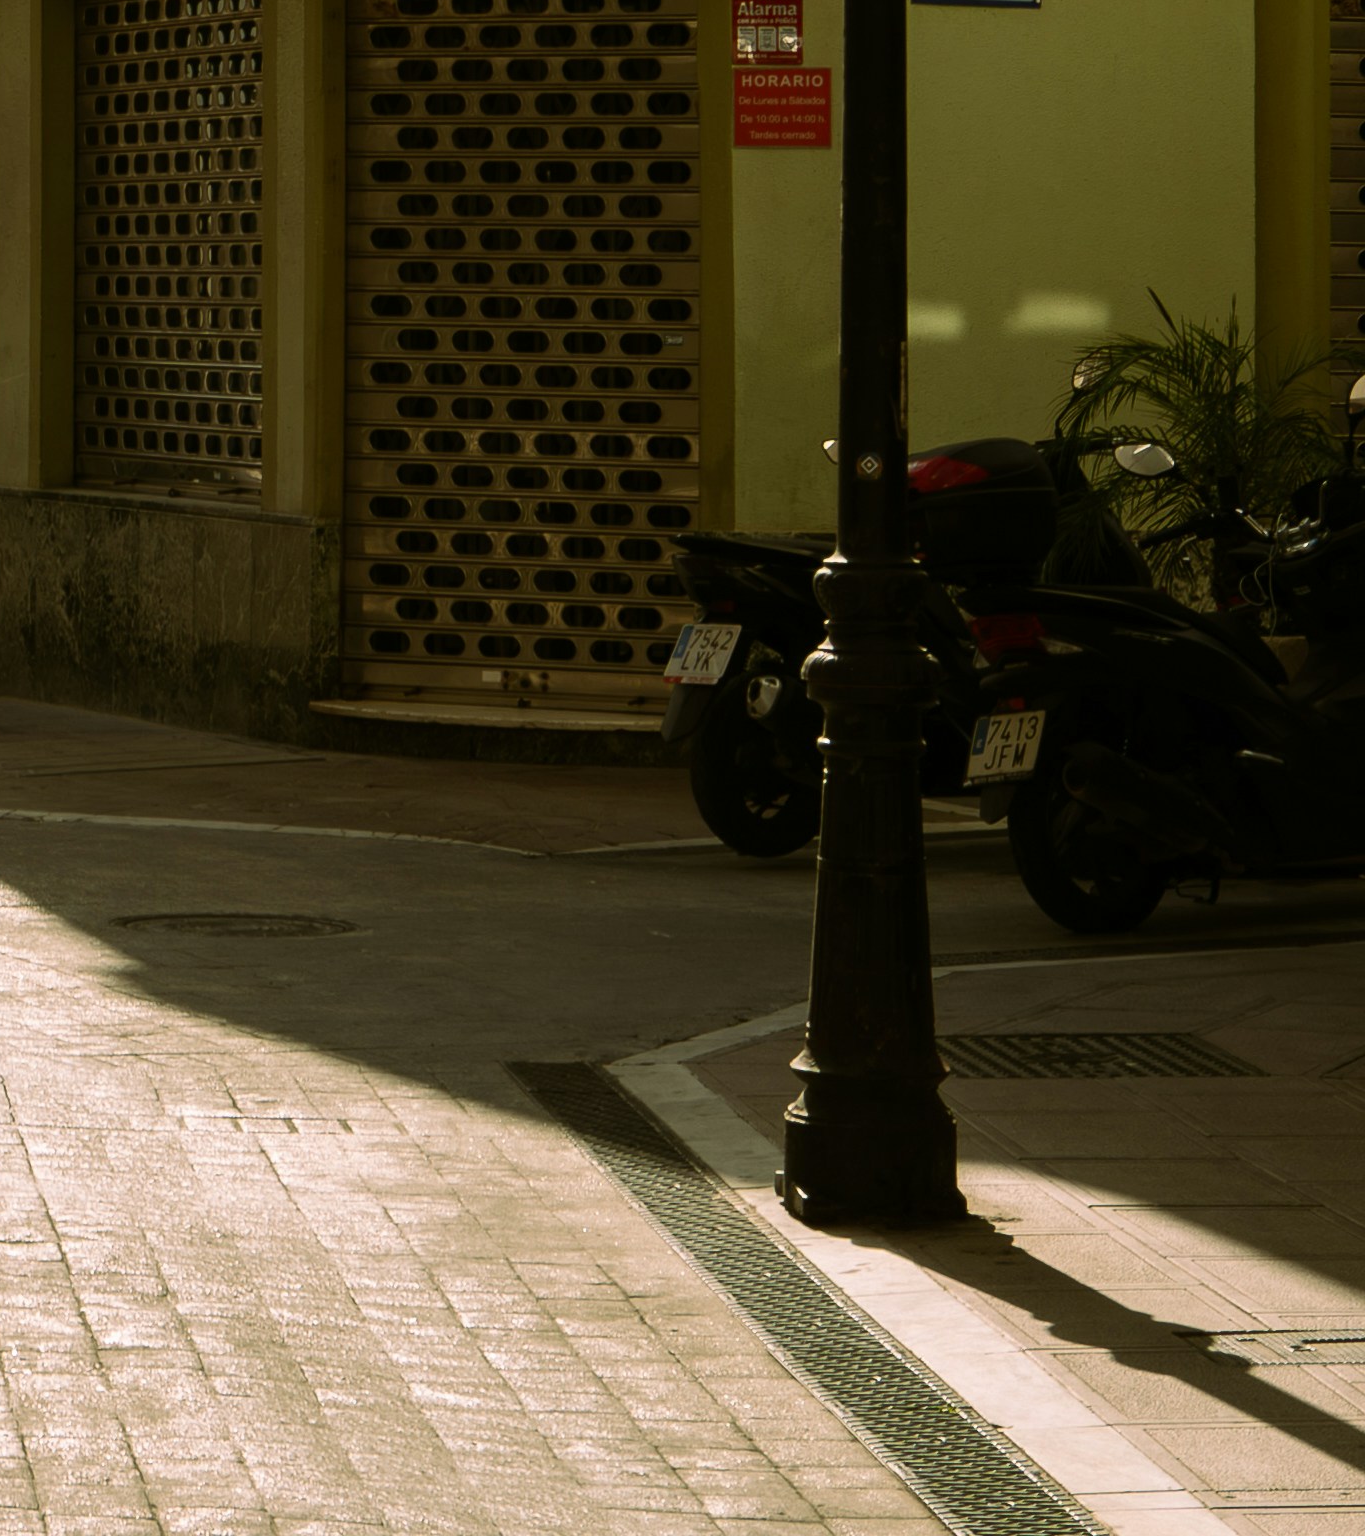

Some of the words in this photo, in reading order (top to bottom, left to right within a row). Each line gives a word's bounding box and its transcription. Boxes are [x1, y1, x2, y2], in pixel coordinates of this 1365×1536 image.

[737, 0, 797, 16] Alarma
[741, 74, 824, 88] HORARIO
[739, 96, 752, 106] De
[753, 96, 779, 106] Lunes
[740, 114, 753, 124] De
[749, 130, 779, 140] Tardes
[781, 130, 816, 140] cerrado
[689, 629, 734, 651] 7542
[681, 650, 716, 672] LYK
[987, 716, 1039, 745] 7413
[984, 742, 1027, 770] JFM
